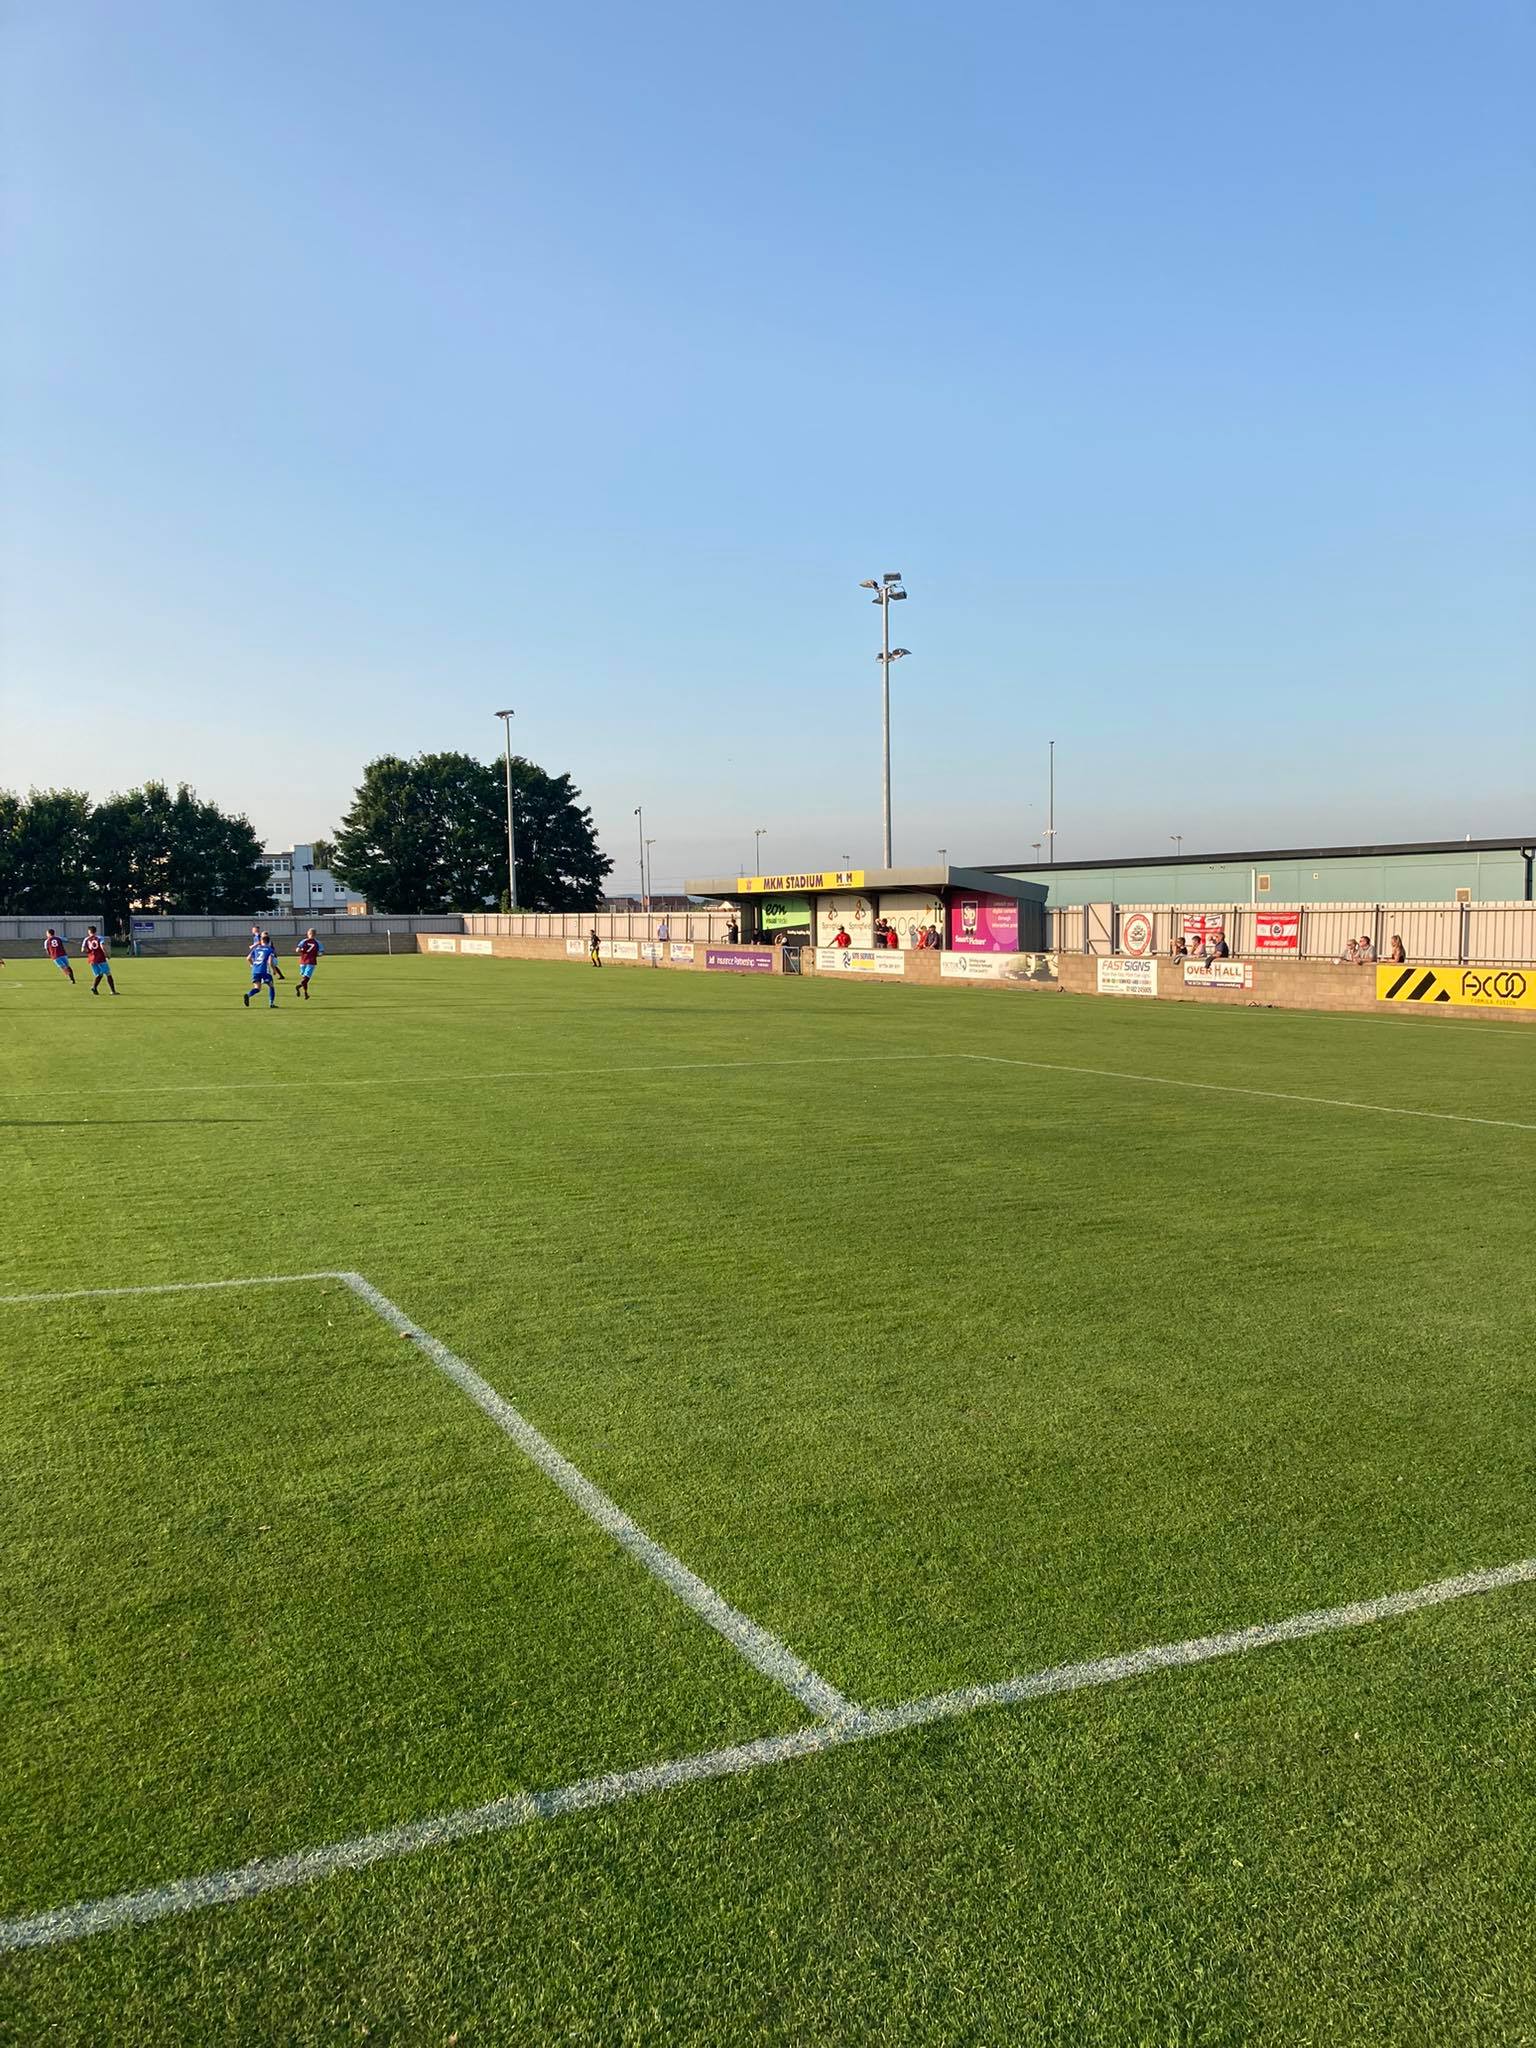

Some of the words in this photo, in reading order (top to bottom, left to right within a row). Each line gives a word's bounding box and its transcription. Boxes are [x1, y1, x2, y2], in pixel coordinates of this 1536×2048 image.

[764, 877, 784, 890] MKM
[786, 875, 824, 889] STADIUM
[934, 901, 943, 923] it
[51, 939, 58, 947] 8
[87, 940, 99, 950] 10
[307, 943, 314, 953] 7
[1102, 960, 1151, 972] FASTSIGNS
